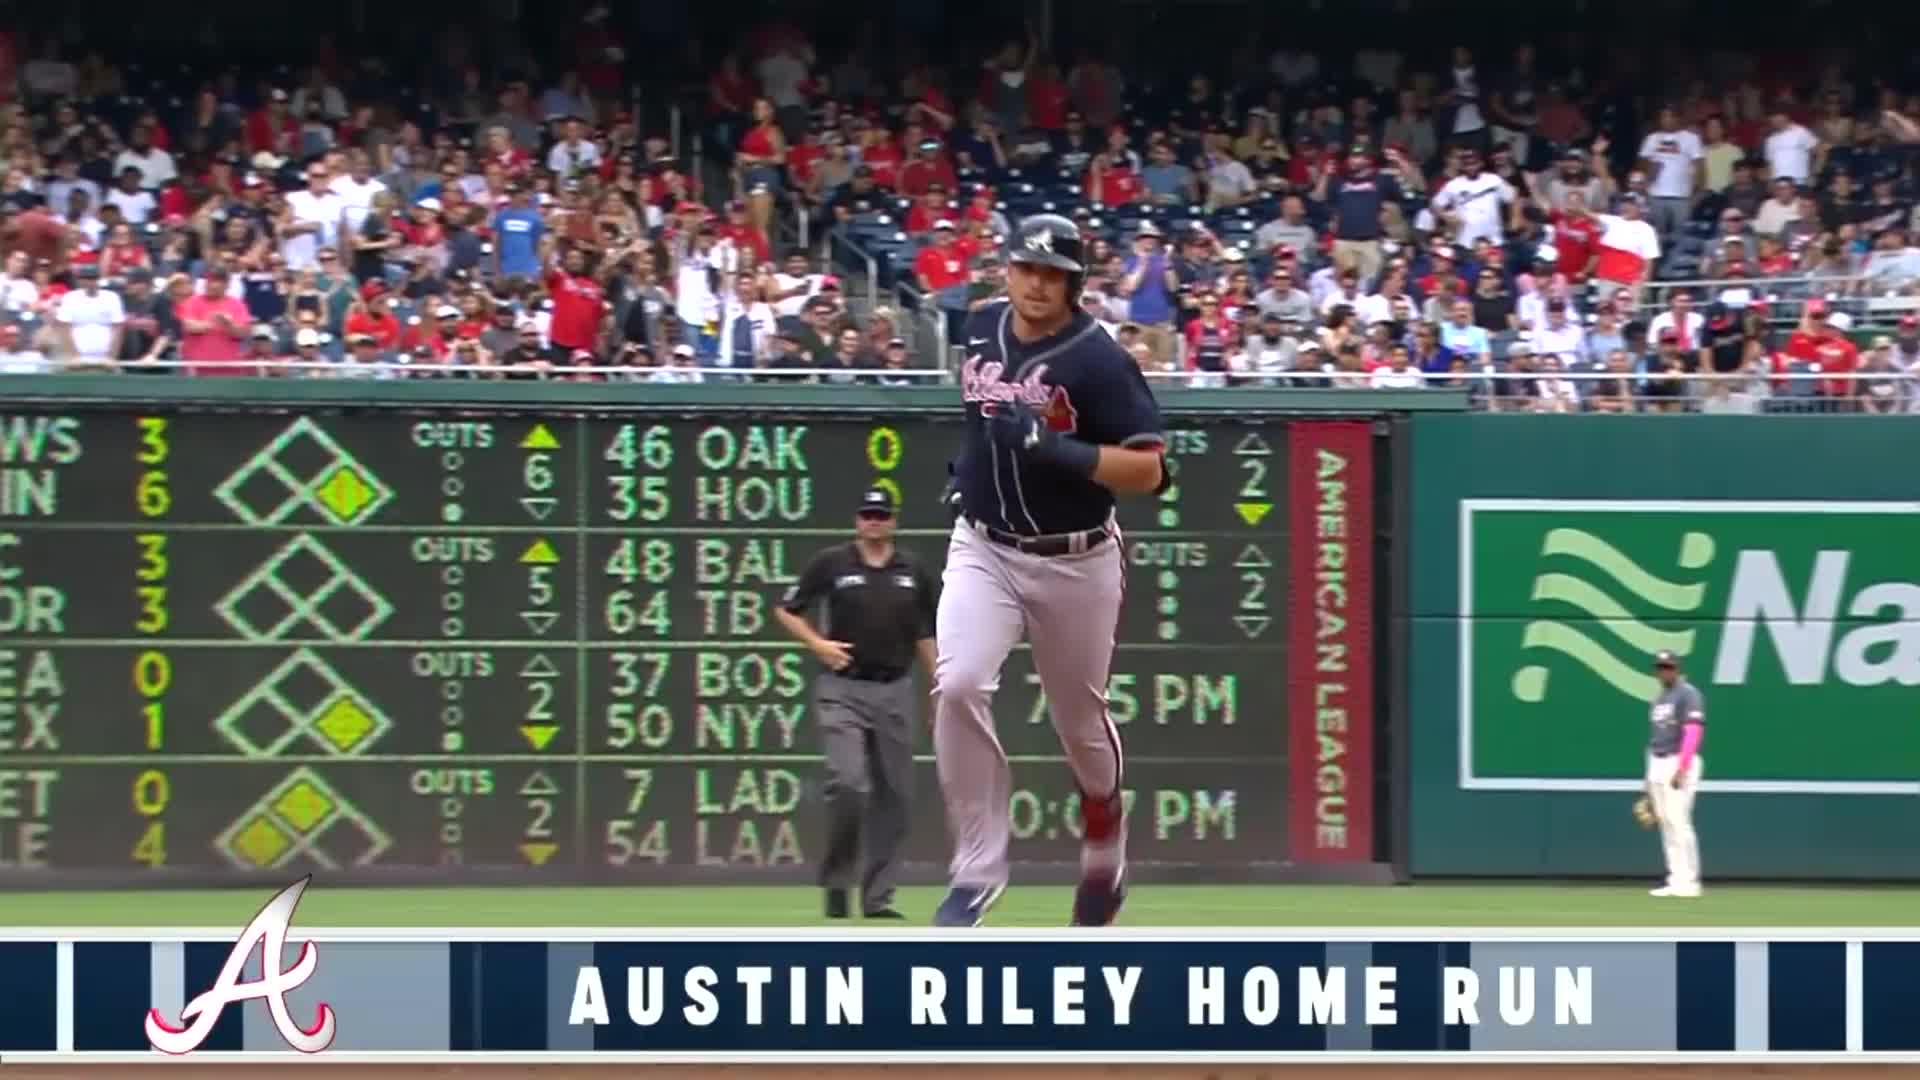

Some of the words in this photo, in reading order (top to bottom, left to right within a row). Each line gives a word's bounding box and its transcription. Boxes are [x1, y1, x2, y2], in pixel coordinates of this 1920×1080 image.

[136, 417, 169, 464] 3
[411, 422, 494, 447] OUTS
[605, 425, 673, 469] 46
[696, 425, 809, 470] OAK
[867, 427, 902, 470] 0
[136, 470, 171, 516] 6
[524, 454, 553, 491] 6
[1240, 458, 1266, 497] 2
[608, 476, 669, 520] 35
[697, 476, 812, 521] HOU
[135, 534, 168, 580] 3
[411, 537, 494, 562] OUTS
[606, 540, 673, 583] 48
[697, 540, 798, 583] BAL
[1129, 542, 1208, 567] OUTS
[1315, 449, 1347, 672] AMERICAN
[529, 567, 552, 604] 5
[1240, 571, 1266, 609] 2
[135, 586, 168, 633] 3
[607, 591, 672, 634] 64
[698, 591, 764, 634] TB
[133, 650, 171, 698] 0
[411, 652, 494, 676] OUTS
[610, 653, 669, 697] 37
[697, 653, 803, 697] BOS
[526, 682, 553, 720] 2
[1153, 674, 1236, 725] PM
[140, 702, 163, 750] 1
[607, 704, 673, 748] 50
[698, 704, 805, 749] NYY
[410, 769, 494, 794] OUTS
[1315, 684, 1348, 849] LEAGUE
[132, 769, 170, 816] 0
[623, 769, 653, 813] 7
[697, 769, 801, 814] LAD
[526, 801, 553, 838] 2
[1153, 790, 1236, 840] PM
[131, 821, 166, 865] 4
[607, 820, 671, 864] 54
[698, 820, 803, 865] LAA
